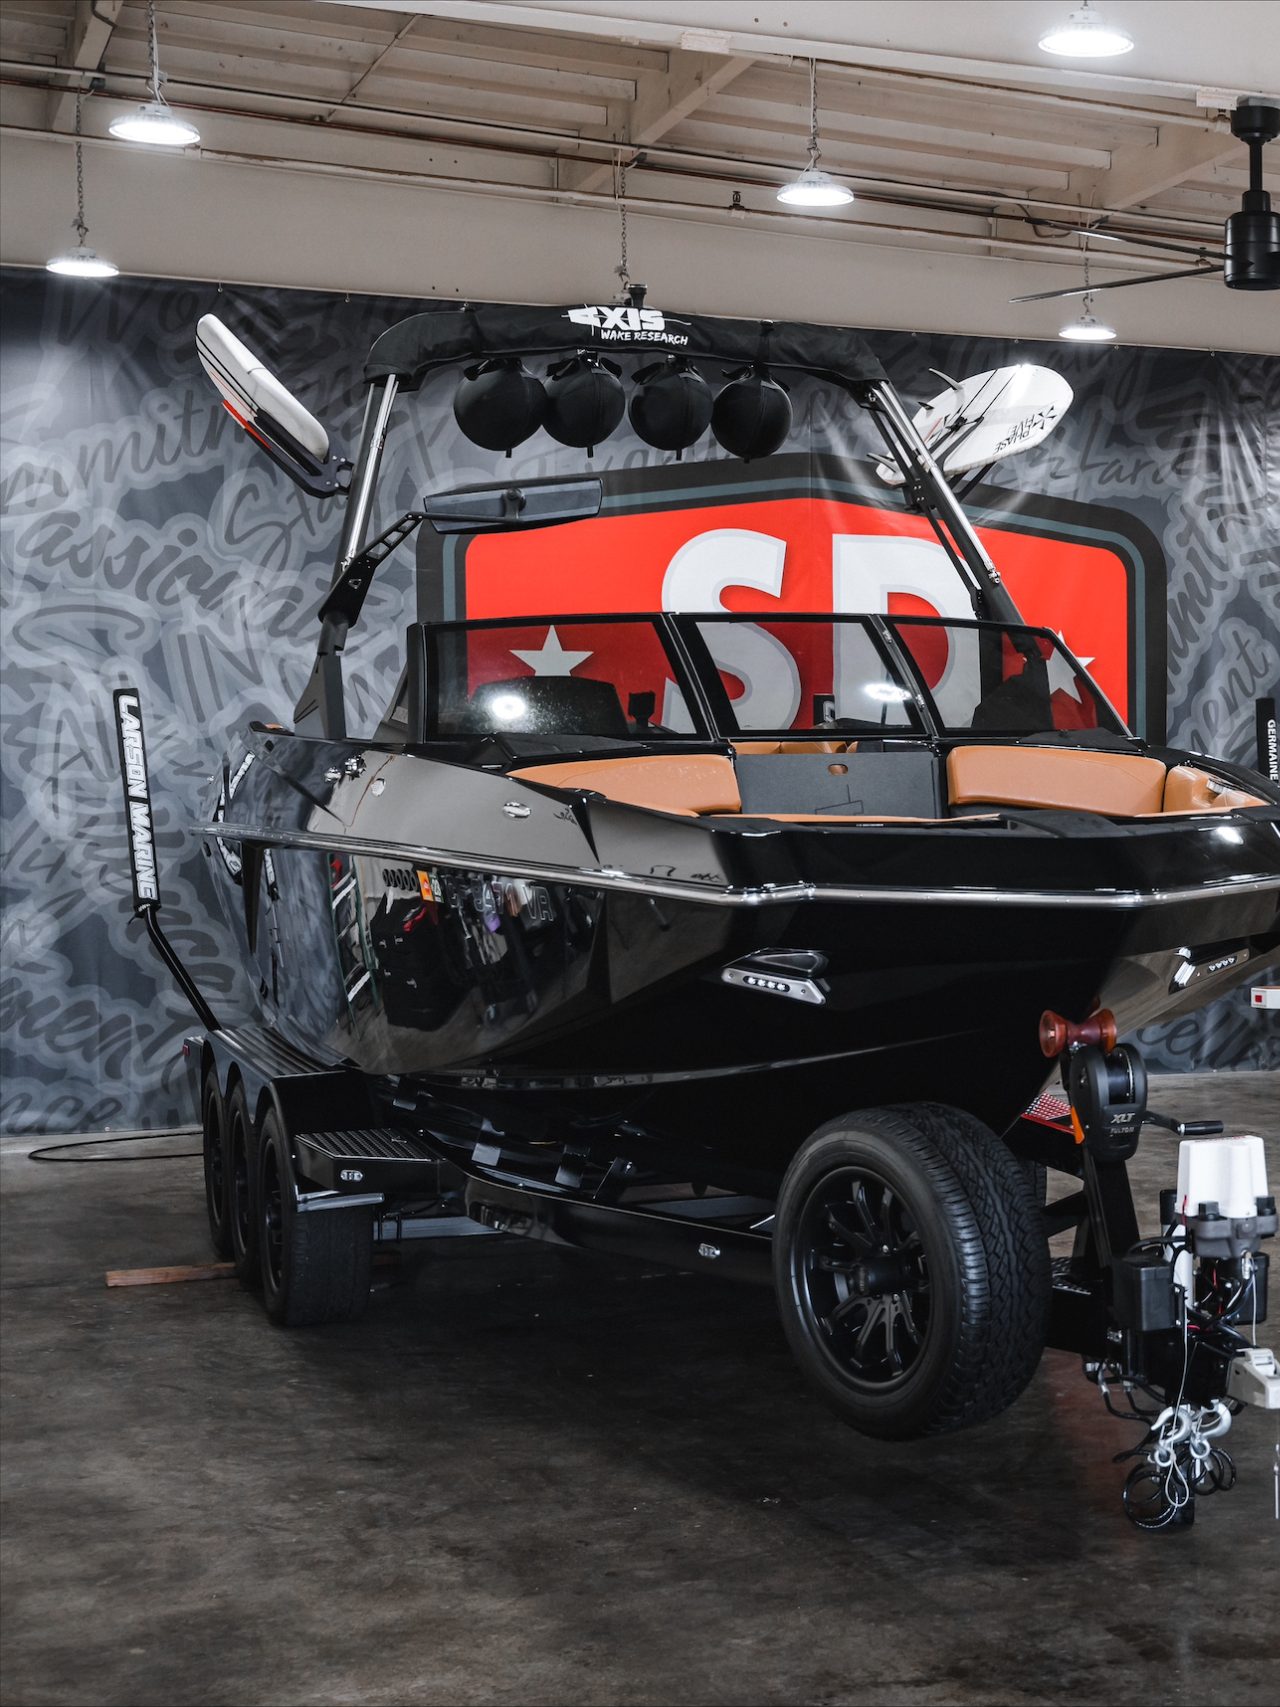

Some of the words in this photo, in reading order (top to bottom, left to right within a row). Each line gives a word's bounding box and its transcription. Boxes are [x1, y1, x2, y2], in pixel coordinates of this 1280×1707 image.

[600, 329, 632, 342] WAKE
[633, 330, 689, 346] RESEARCH
[118, 695, 147, 799] LARSON
[1265, 719, 1280, 780] GERMAINE
[129, 802, 157, 901] MARINE
[1110, 1112, 1136, 1124] XLT
